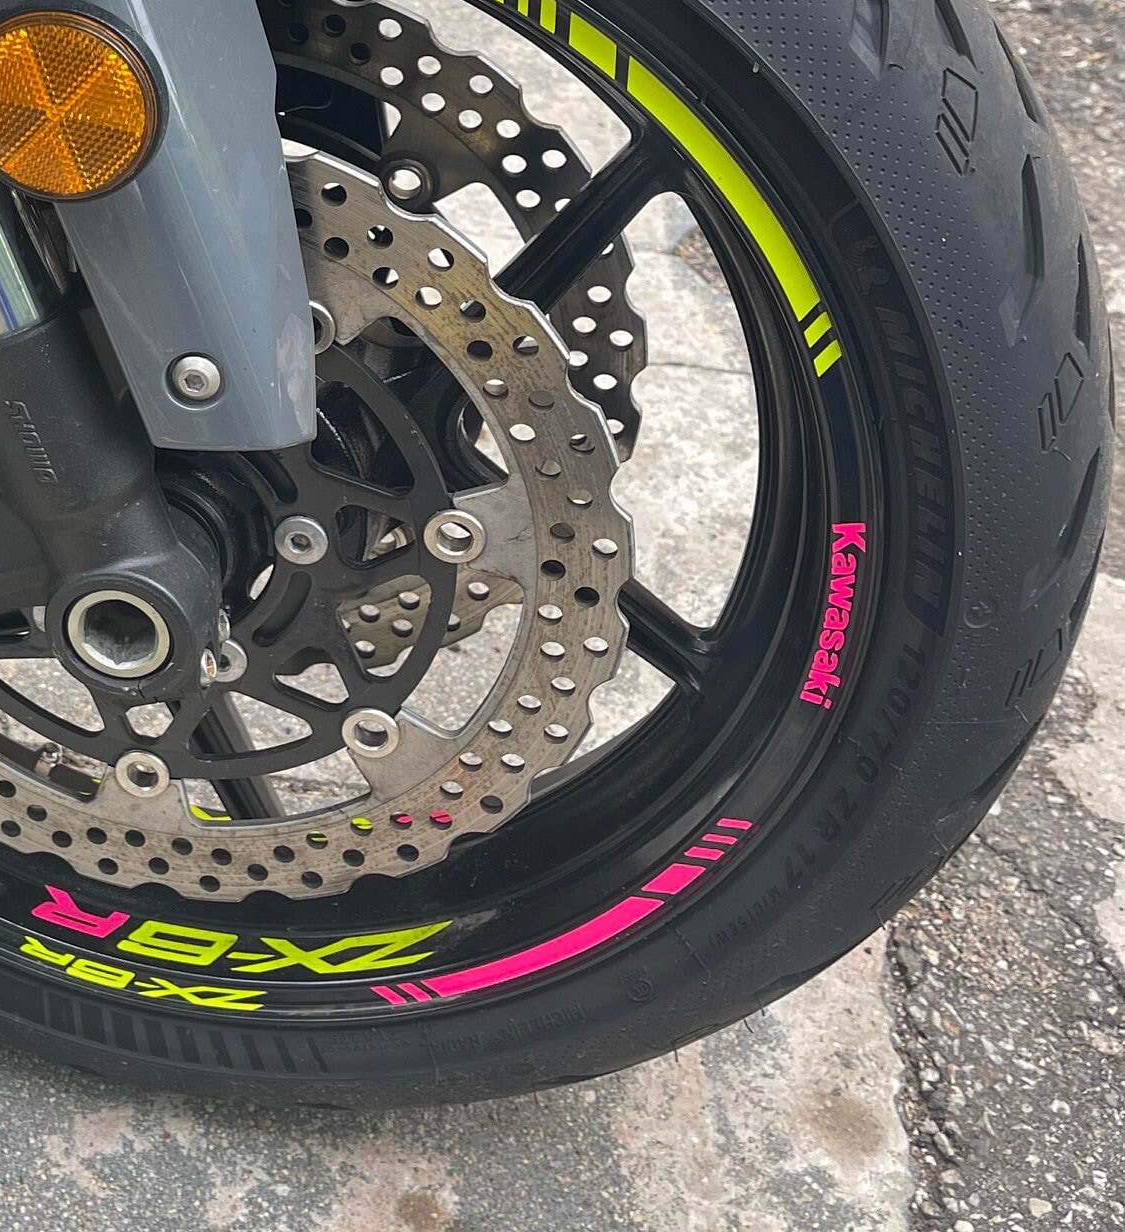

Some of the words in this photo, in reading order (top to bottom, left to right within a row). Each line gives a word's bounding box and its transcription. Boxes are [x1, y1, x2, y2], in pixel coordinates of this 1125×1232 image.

[873, 307, 946, 609] MICHELIN
[798, 520, 867, 711] Kawasaki
[19, 935, 268, 1012] ZX-6R
[30, 883, 454, 975] ZX-6R
